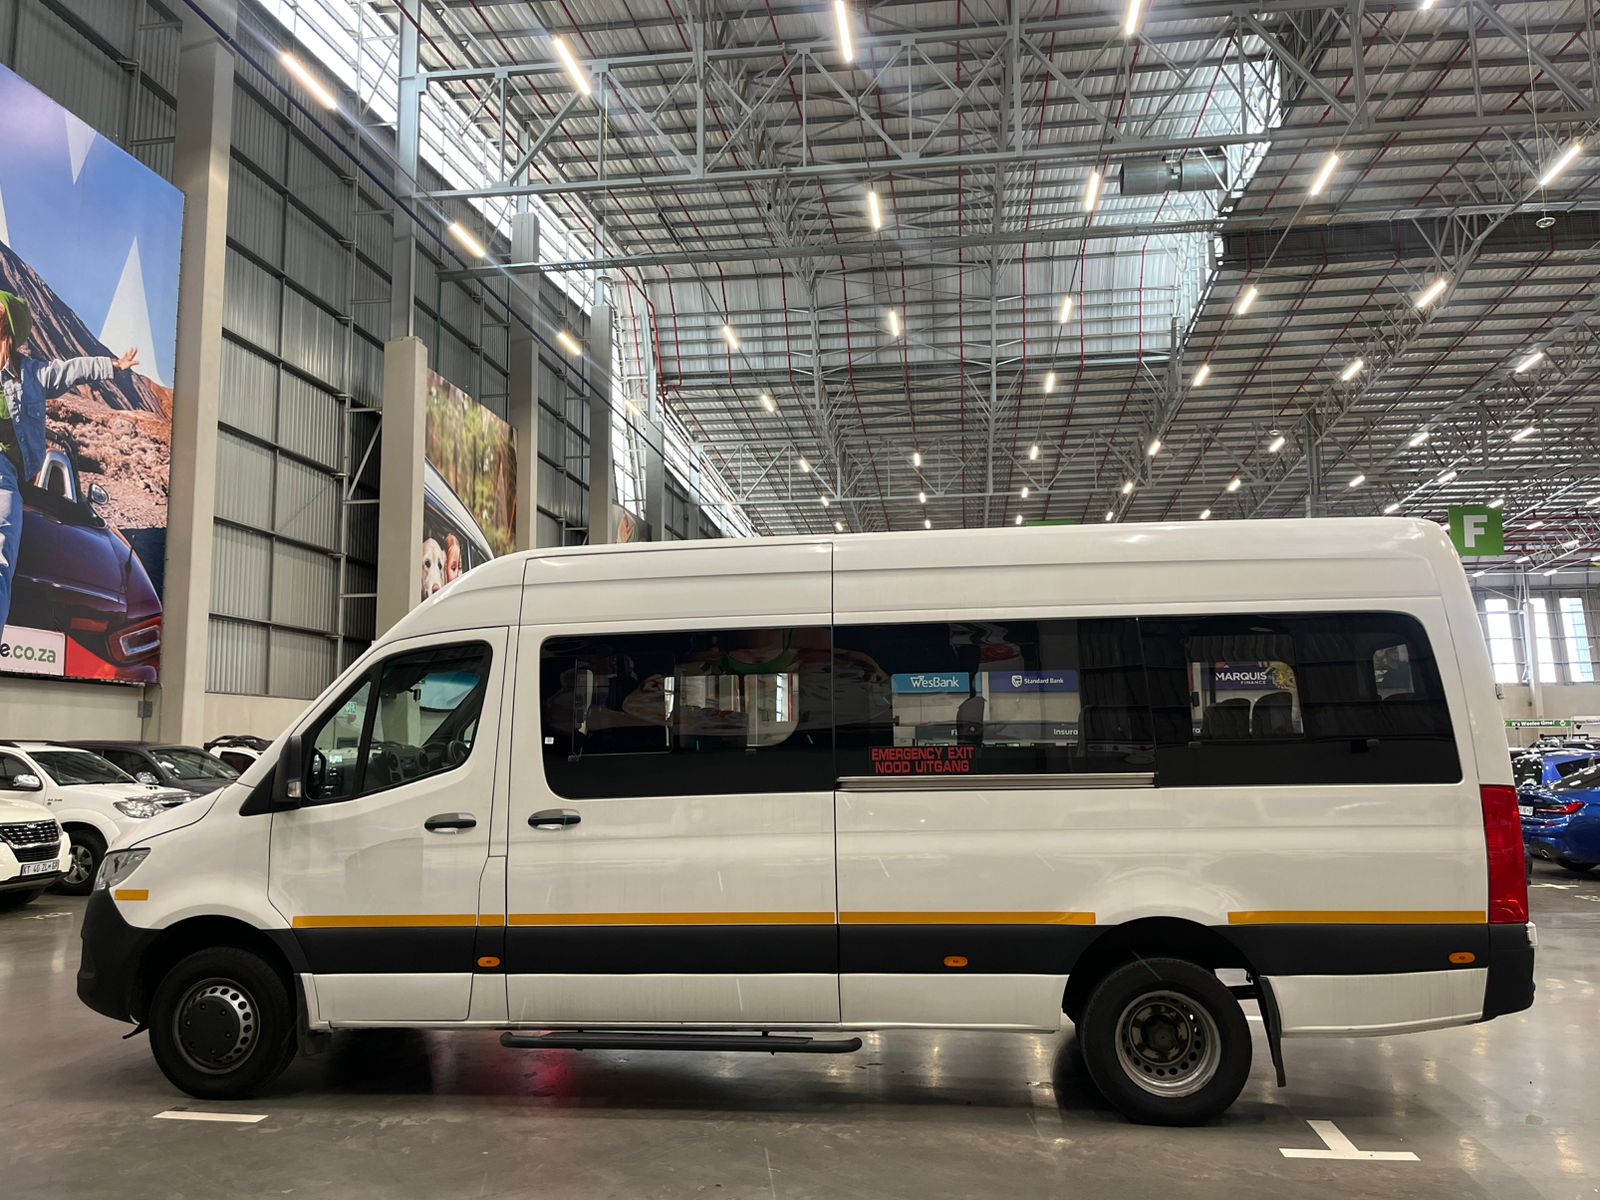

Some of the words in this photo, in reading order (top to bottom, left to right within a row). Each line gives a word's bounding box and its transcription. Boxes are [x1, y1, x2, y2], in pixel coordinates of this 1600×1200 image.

[1463, 515, 1488, 548] F
[910, 676, 960, 688] WesBank
[1215, 671, 1267, 681] MARQUIS
[871, 747, 942, 761] EMERGENCY
[947, 746, 974, 760] EXIT
[875, 760, 911, 774] NOOD
[915, 759, 970, 773] UITGANG
